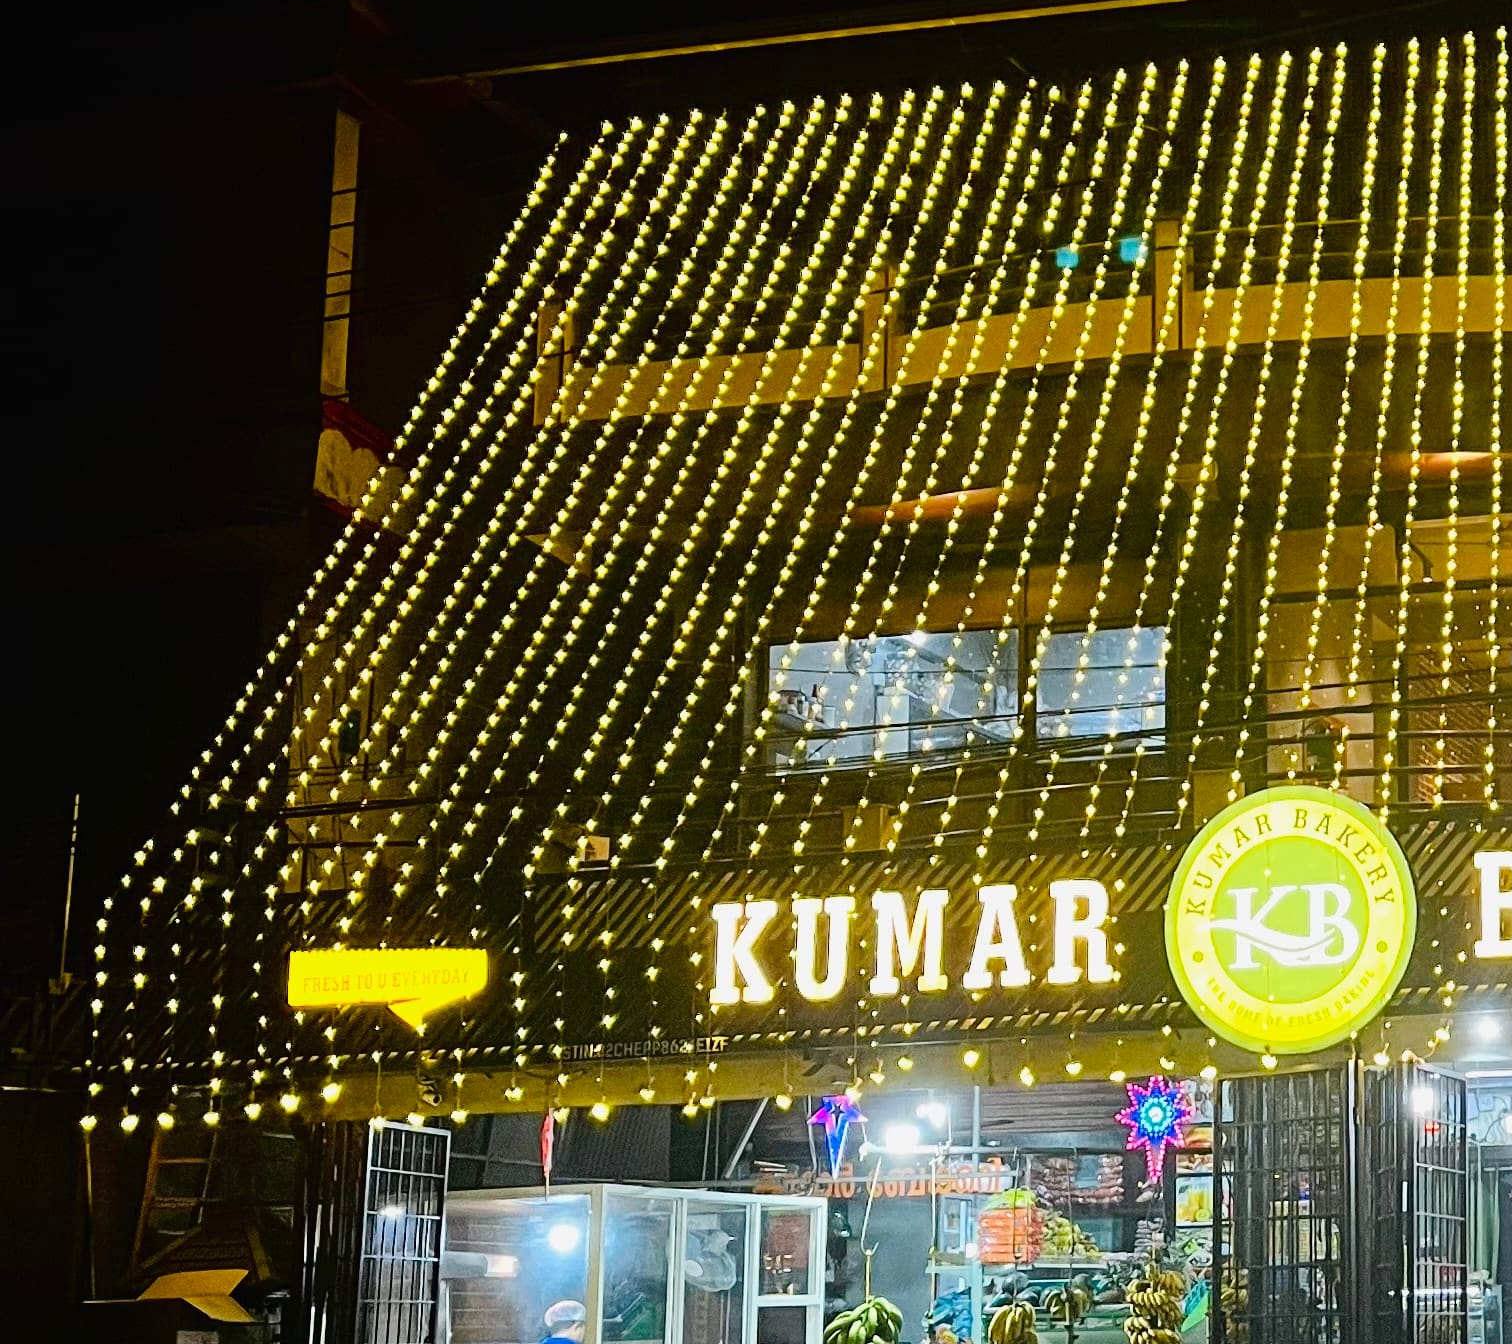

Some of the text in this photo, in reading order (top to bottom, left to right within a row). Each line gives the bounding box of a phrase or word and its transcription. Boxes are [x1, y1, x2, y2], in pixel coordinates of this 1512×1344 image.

[1185, 807, 1395, 917] KUMAR BAKERY
[708, 877, 1116, 1007] KUMAR
[1208, 882, 1361, 971] KB
[302, 967, 471, 993] FRESH TO U EVERYDAY
